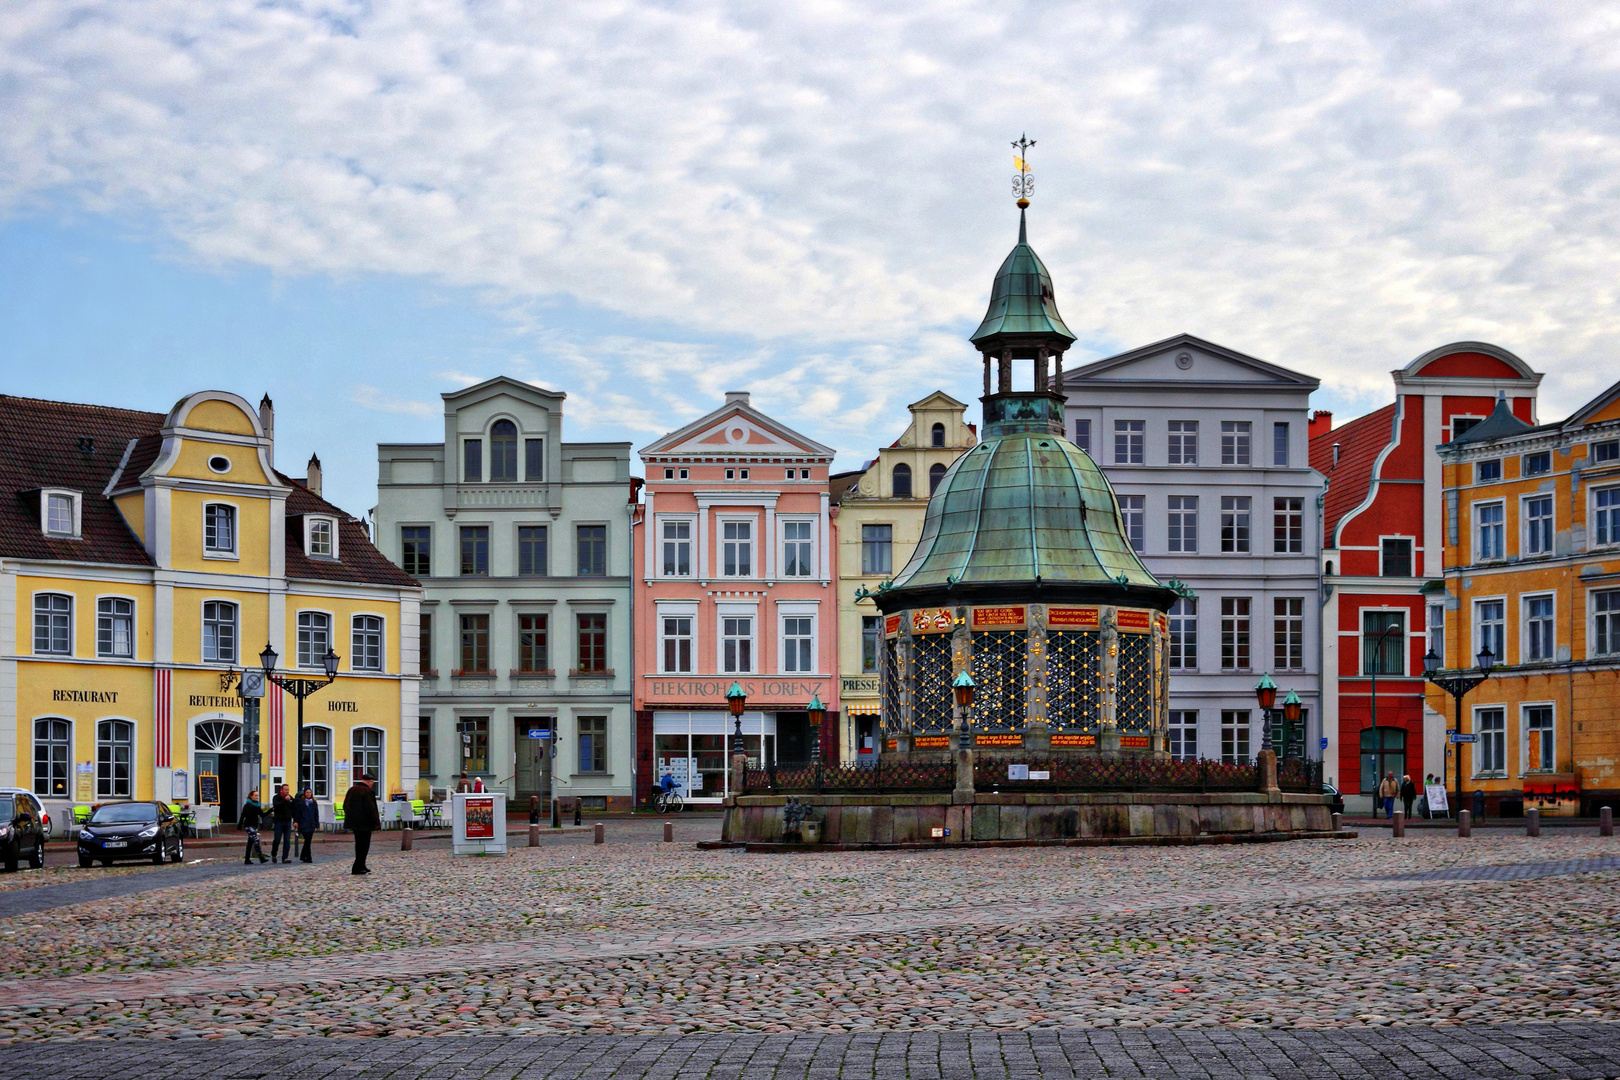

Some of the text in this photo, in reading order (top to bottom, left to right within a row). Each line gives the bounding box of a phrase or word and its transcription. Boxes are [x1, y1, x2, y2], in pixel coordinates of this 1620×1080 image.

[763, 682, 823, 696] LORENZ
[53, 690, 118, 703] RESTAURANT
[328, 701, 358, 712] HOTEL
